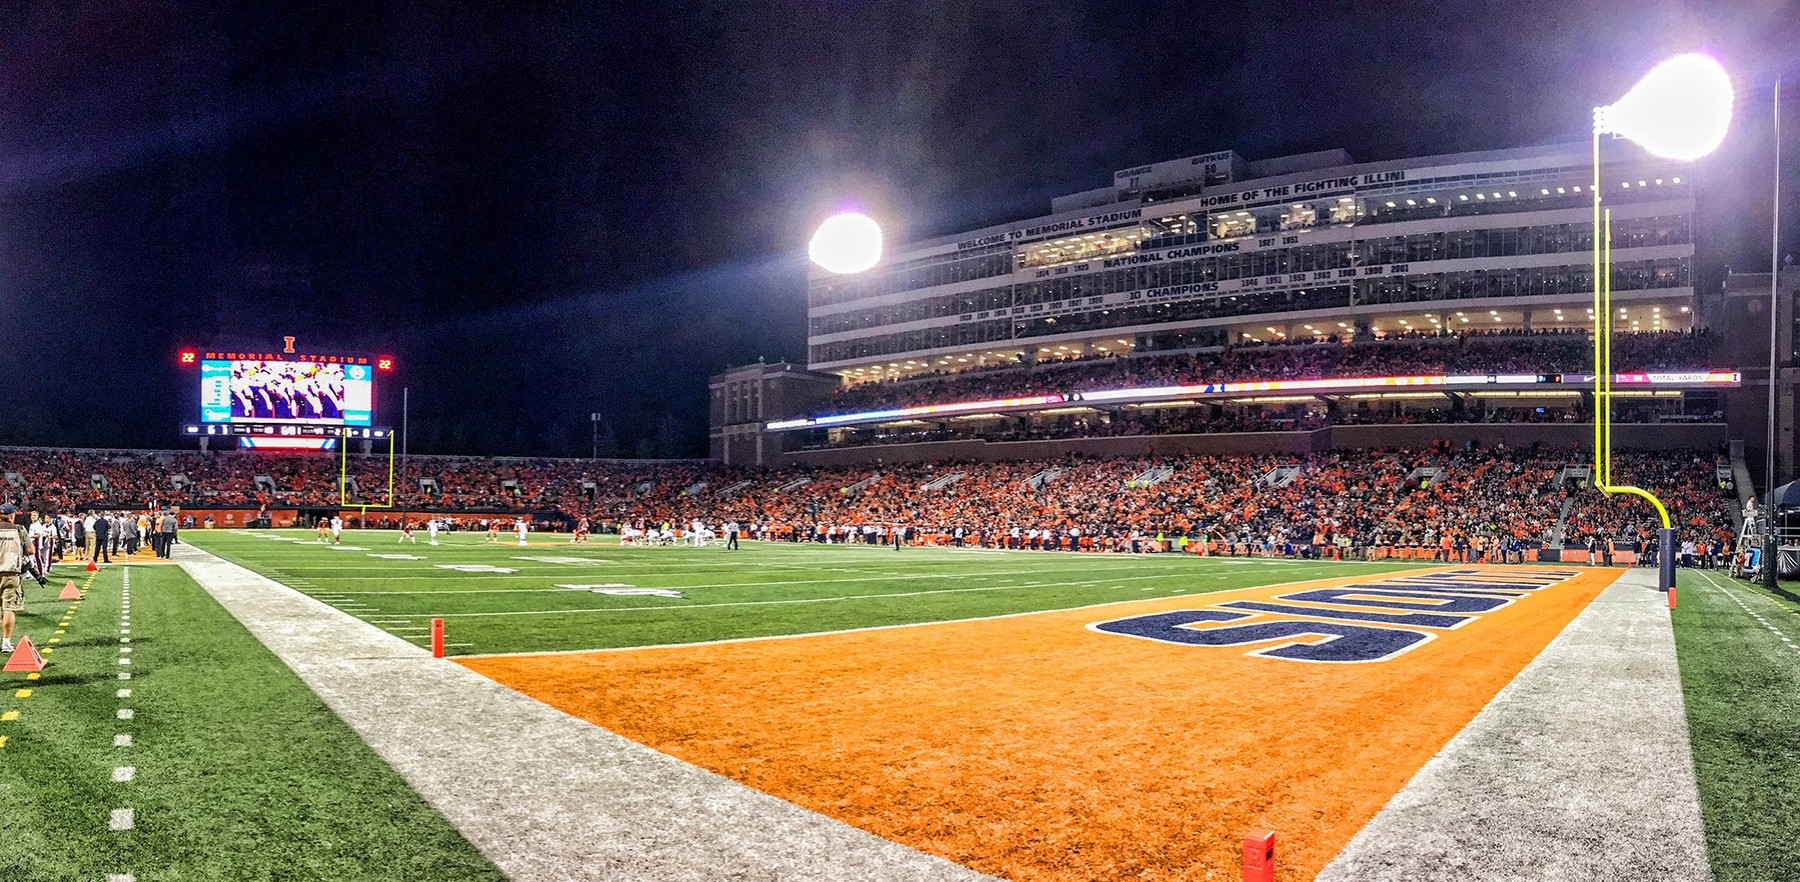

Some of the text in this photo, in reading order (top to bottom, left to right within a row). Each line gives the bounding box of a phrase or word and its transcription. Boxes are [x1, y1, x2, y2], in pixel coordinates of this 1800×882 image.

[1204, 164, 1217, 174] 50
[1200, 171, 1405, 207] HOME OF THE FIGHTING ILLINI
[957, 209, 1142, 250] WELCOME TO MEMORIAL STADIUM
[1103, 242, 1240, 269] NATIONAL CHAMPIONS
[1146, 282, 1219, 298] CHAMPIONS
[206, 352, 367, 364] MEMORIAL STADIUM
